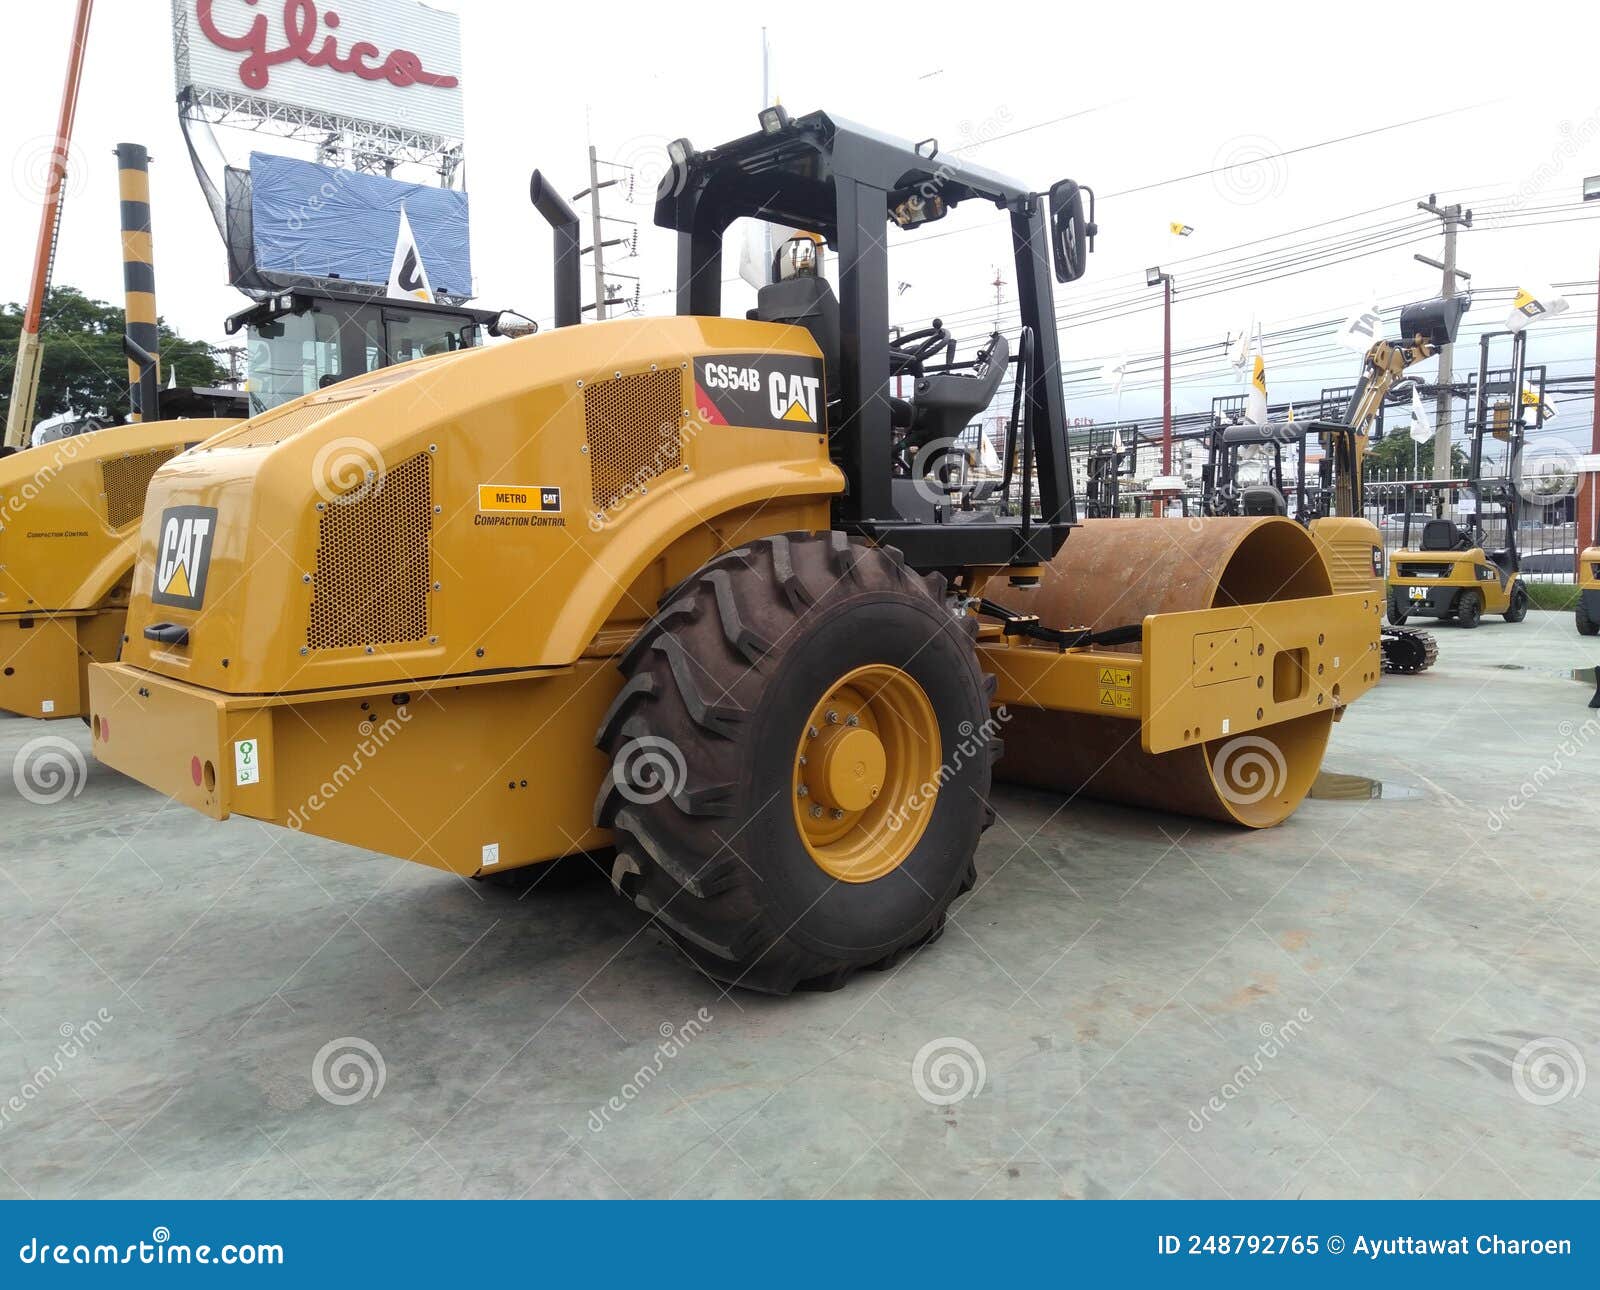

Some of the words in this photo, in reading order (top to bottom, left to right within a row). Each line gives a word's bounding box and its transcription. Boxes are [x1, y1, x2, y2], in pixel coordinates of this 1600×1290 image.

[705, 363, 760, 392] CS54B
[768, 371, 820, 423] CAT
[496, 493, 527, 504] METRO
[542, 494, 558, 504] CAT
[158, 517, 210, 598] CAT
[1408, 586, 1429, 599] CAT
